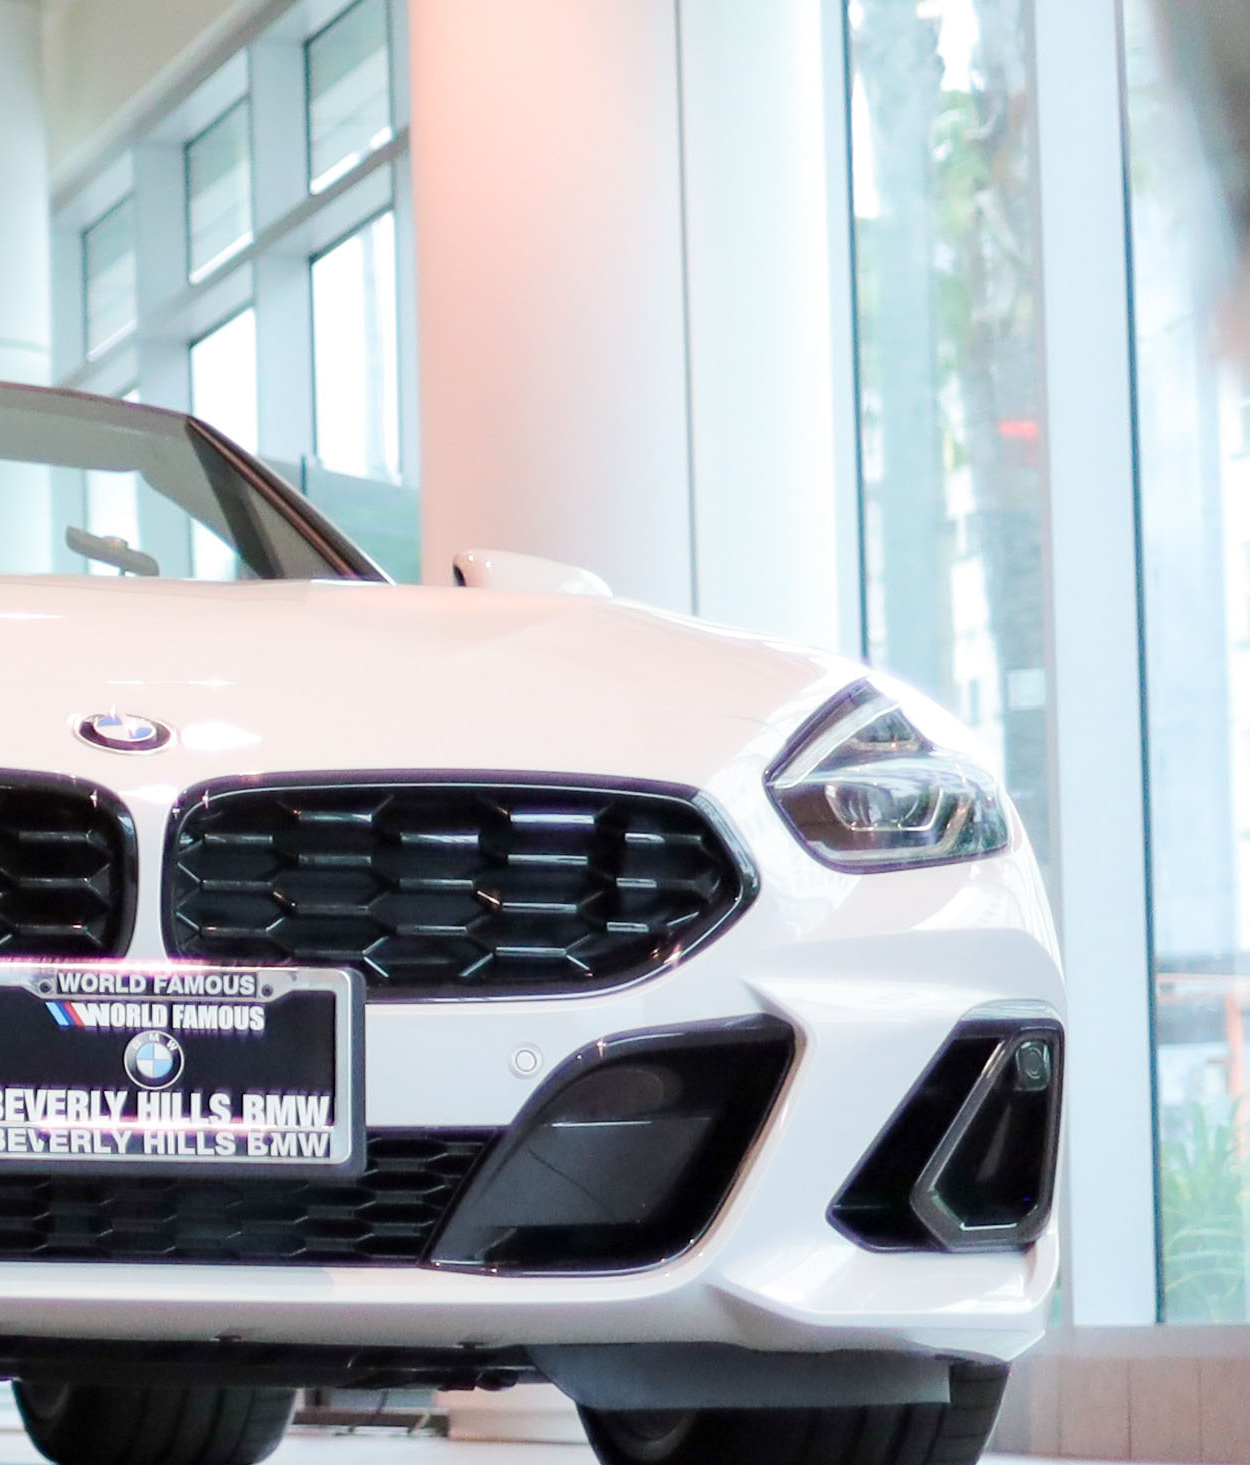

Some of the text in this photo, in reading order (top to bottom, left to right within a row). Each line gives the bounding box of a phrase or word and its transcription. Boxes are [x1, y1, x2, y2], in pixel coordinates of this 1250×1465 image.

[58, 973, 255, 995] WORLD FAMOUS
[70, 1002, 265, 1030] WORLD FAMOUS
[138, 1090, 232, 1126] HILLS
[243, 1093, 330, 1128] BMW
[144, 1129, 237, 1156] HILLS
[247, 1131, 329, 1158] BMW
